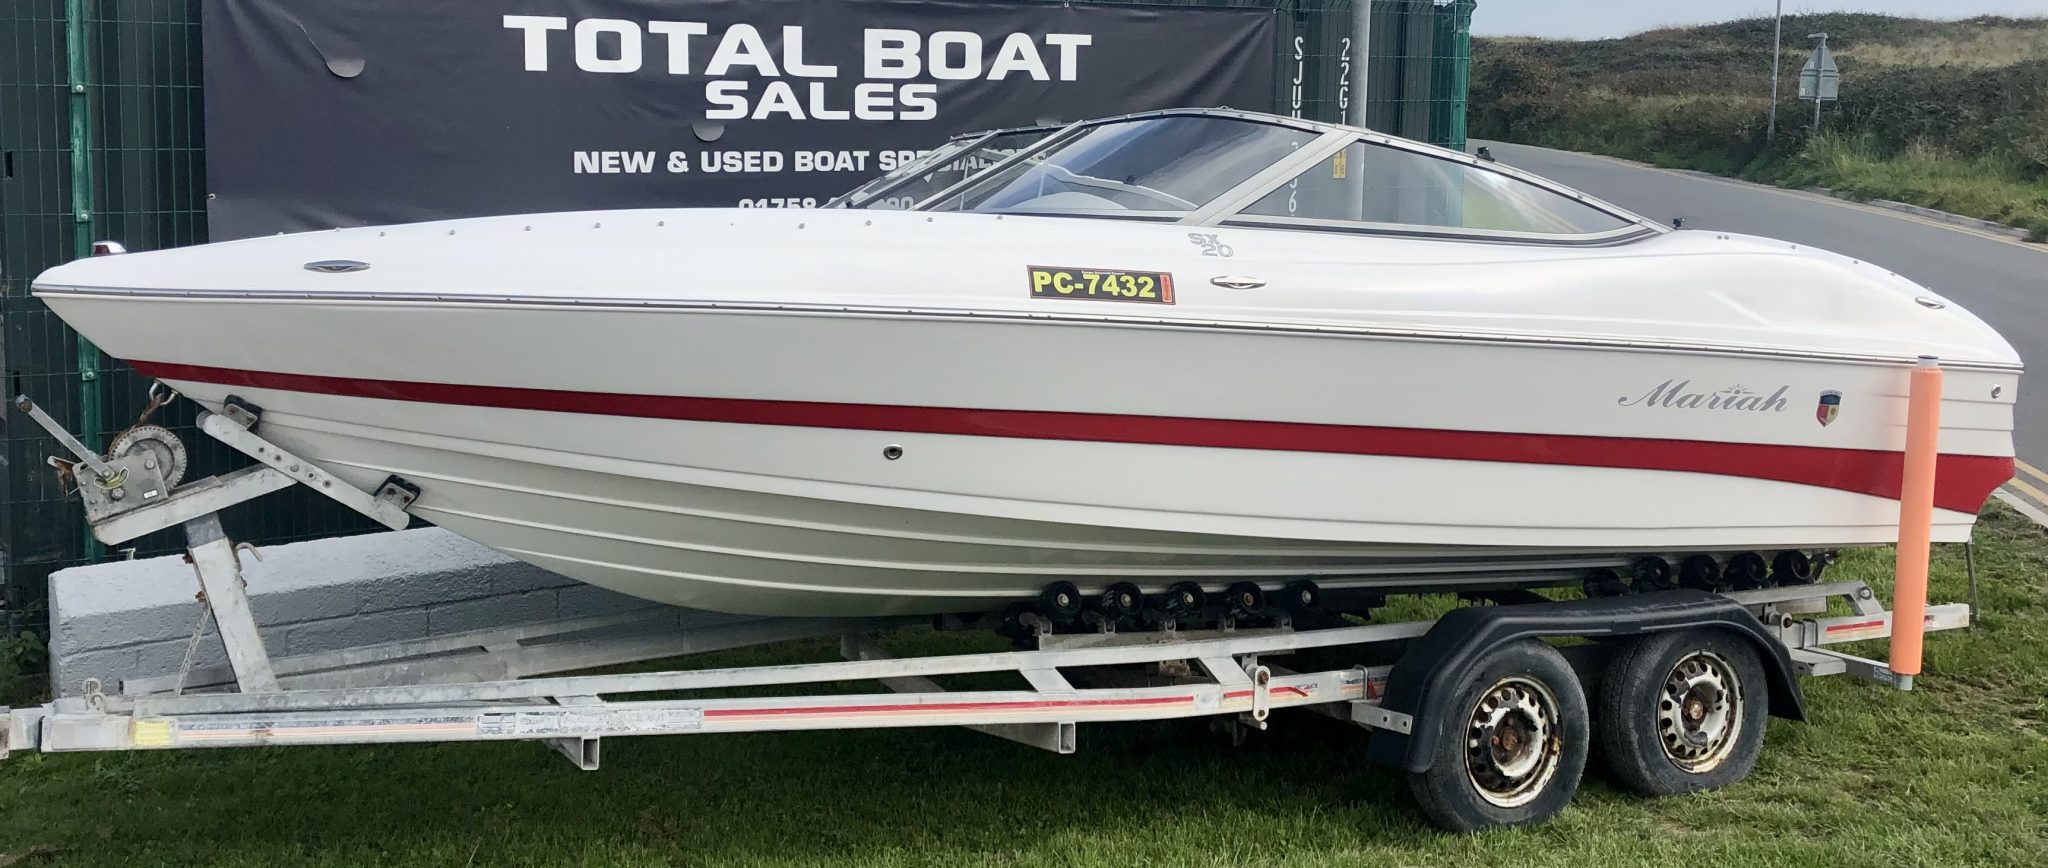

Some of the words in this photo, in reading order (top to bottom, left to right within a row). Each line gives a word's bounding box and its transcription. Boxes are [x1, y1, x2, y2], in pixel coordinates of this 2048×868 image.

[503, 15, 837, 77] TOTAL
[865, 28, 1091, 81] BOAT
[705, 80, 938, 121] SALES
[573, 151, 656, 174] NEW
[667, 151, 689, 173] &
[701, 150, 784, 173] USED
[794, 150, 870, 172] BOAT
[1188, 232, 1221, 245] SX
[1201, 243, 1234, 258] 20
[1033, 271, 1156, 298] PC-7432
[1617, 378, 1790, 412] Mariah
